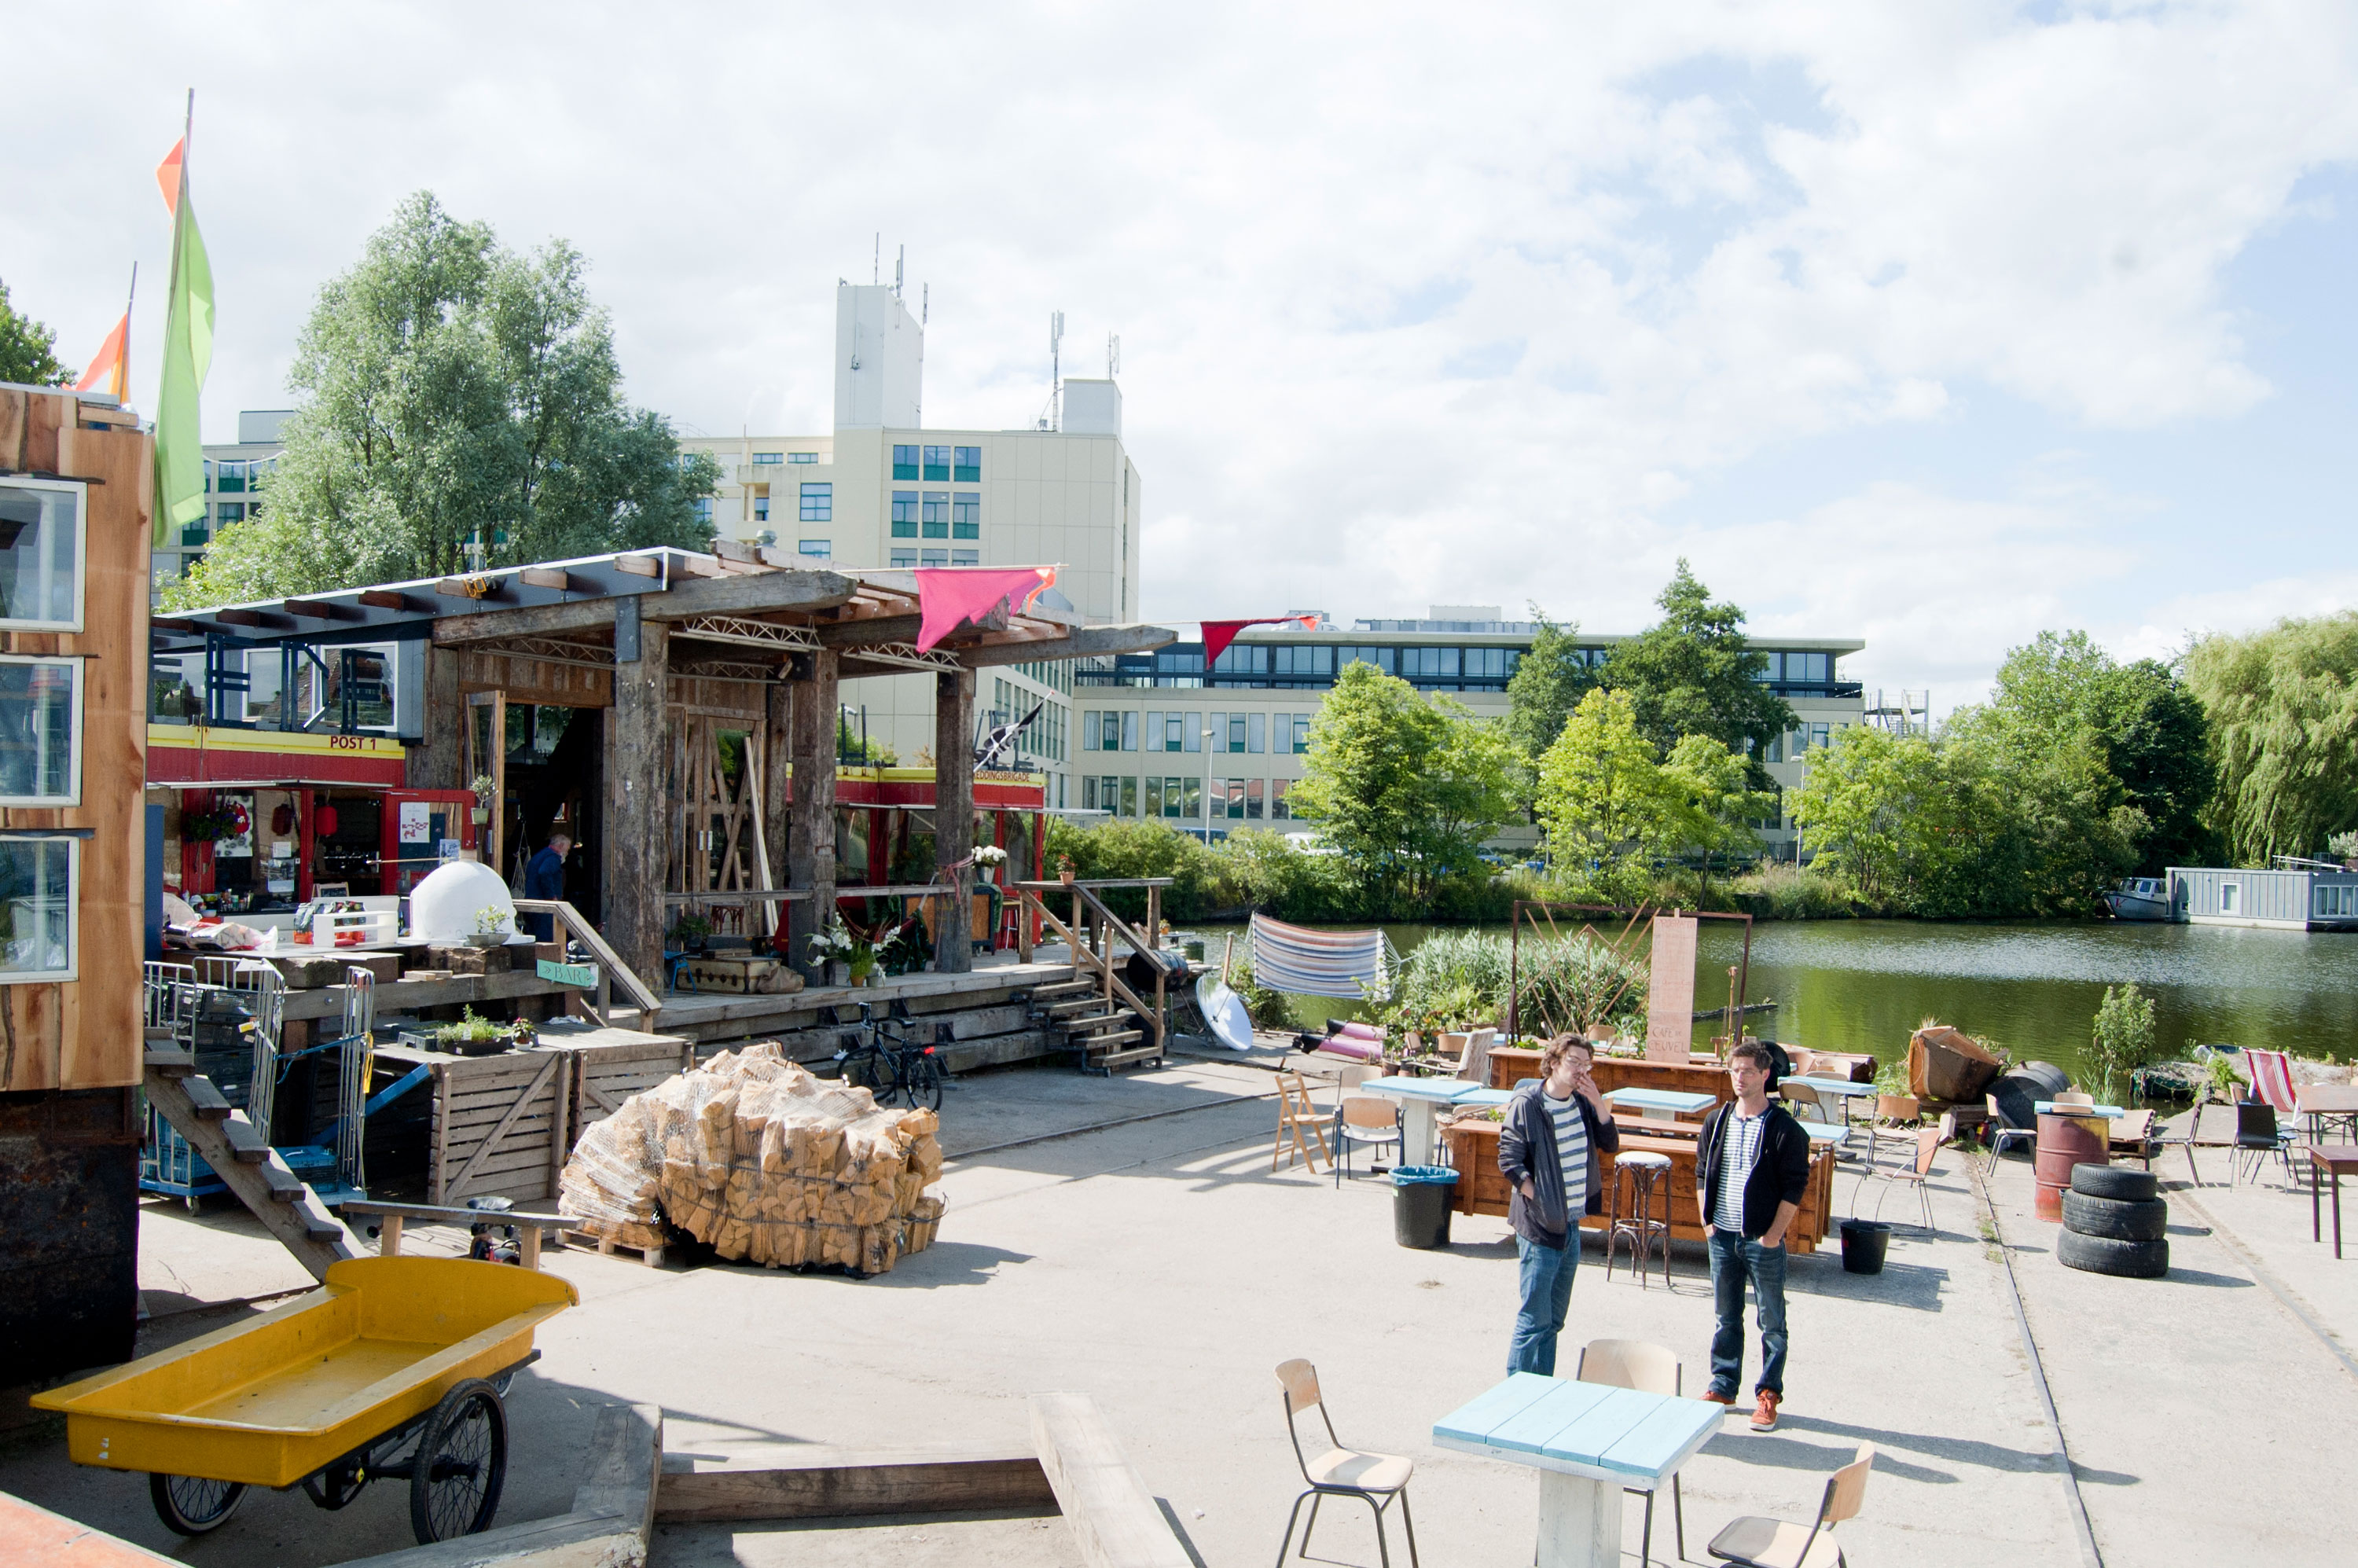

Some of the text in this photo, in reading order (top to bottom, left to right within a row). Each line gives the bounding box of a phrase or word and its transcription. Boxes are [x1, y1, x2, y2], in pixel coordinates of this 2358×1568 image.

[330, 735, 376, 751] POST 1
[554, 966, 583, 983] BAR
[1647, 1040, 1688, 1053] CEUVEL
